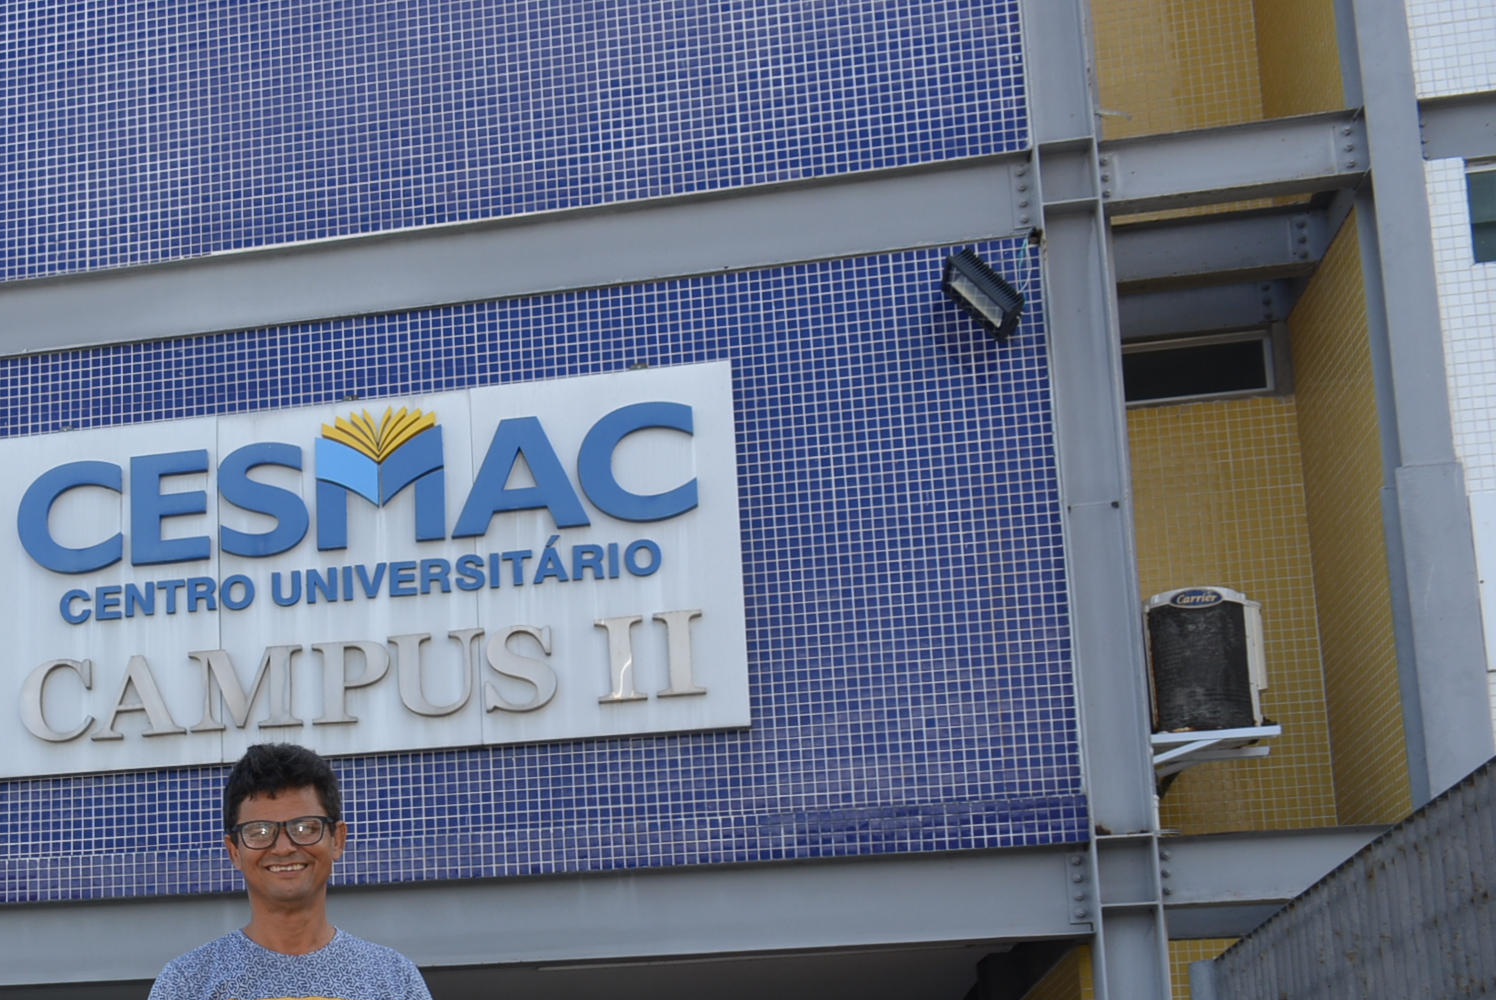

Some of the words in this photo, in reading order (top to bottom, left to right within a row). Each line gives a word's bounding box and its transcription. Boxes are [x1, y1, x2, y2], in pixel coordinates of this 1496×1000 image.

[16, 401, 699, 574] CESMAC
[59, 573, 255, 625] CENTRO
[271, 535, 662, 607] UNIVERSITÁRIO
[1176, 592, 1218, 604] Carrier
[19, 624, 558, 744] CAMPUS
[594, 608, 707, 705] II
